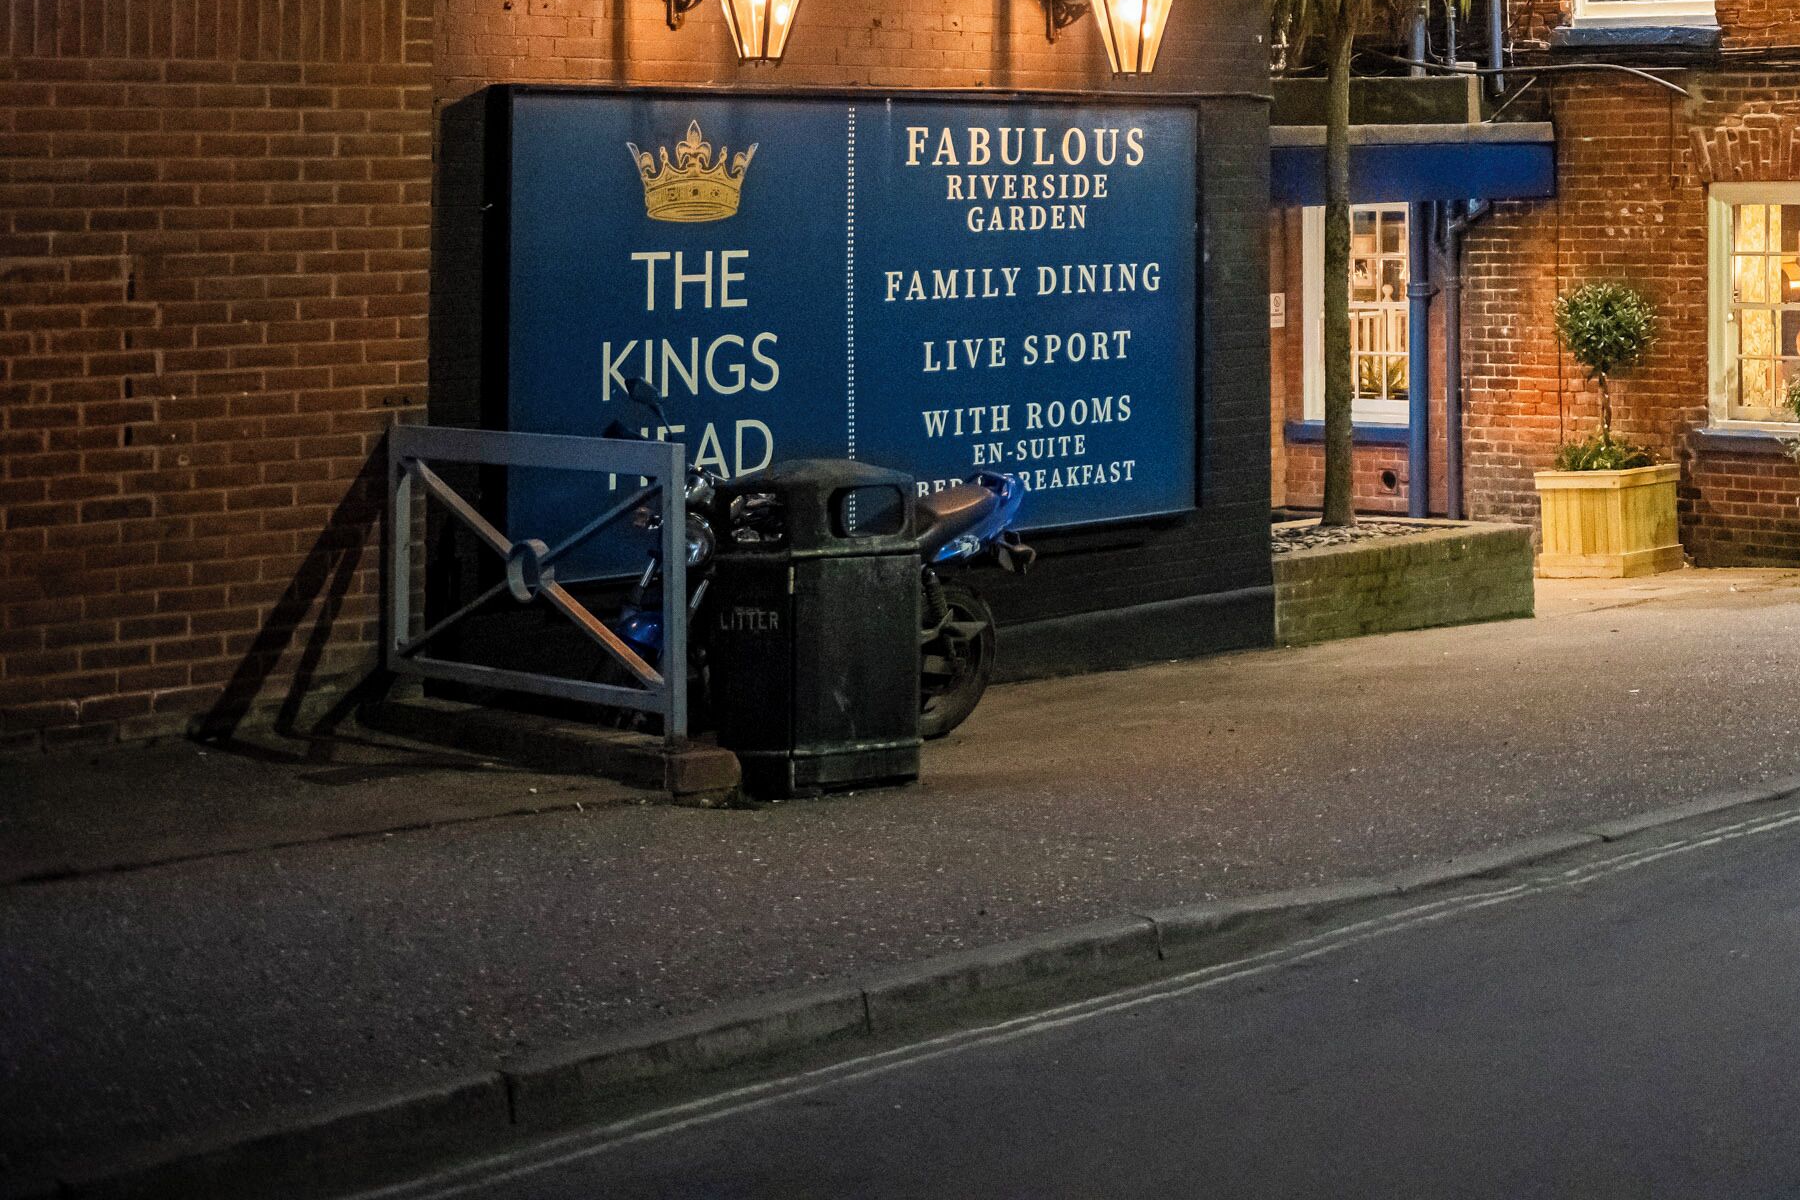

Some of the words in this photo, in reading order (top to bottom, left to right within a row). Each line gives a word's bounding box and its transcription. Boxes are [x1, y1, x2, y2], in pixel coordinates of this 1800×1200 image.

[905, 126, 1145, 167] FABULOUS
[946, 173, 1108, 200] RIVERSIDE
[967, 204, 1087, 233] GARDEN
[631, 249, 749, 311] THE
[885, 267, 1021, 302] FAMILY
[1037, 262, 1162, 296] DINING
[602, 331, 780, 402] KINGS
[923, 337, 1006, 372] LIVE
[1023, 330, 1132, 366] SPORT
[922, 404, 1010, 438] WITH
[1026, 394, 1132, 430] ROOMS
[609, 419, 774, 491] AD
[972, 434, 1087, 465] EN-SUITE
[1004, 460, 1136, 492] REAKFAST
[720, 611, 779, 631] LITTER
